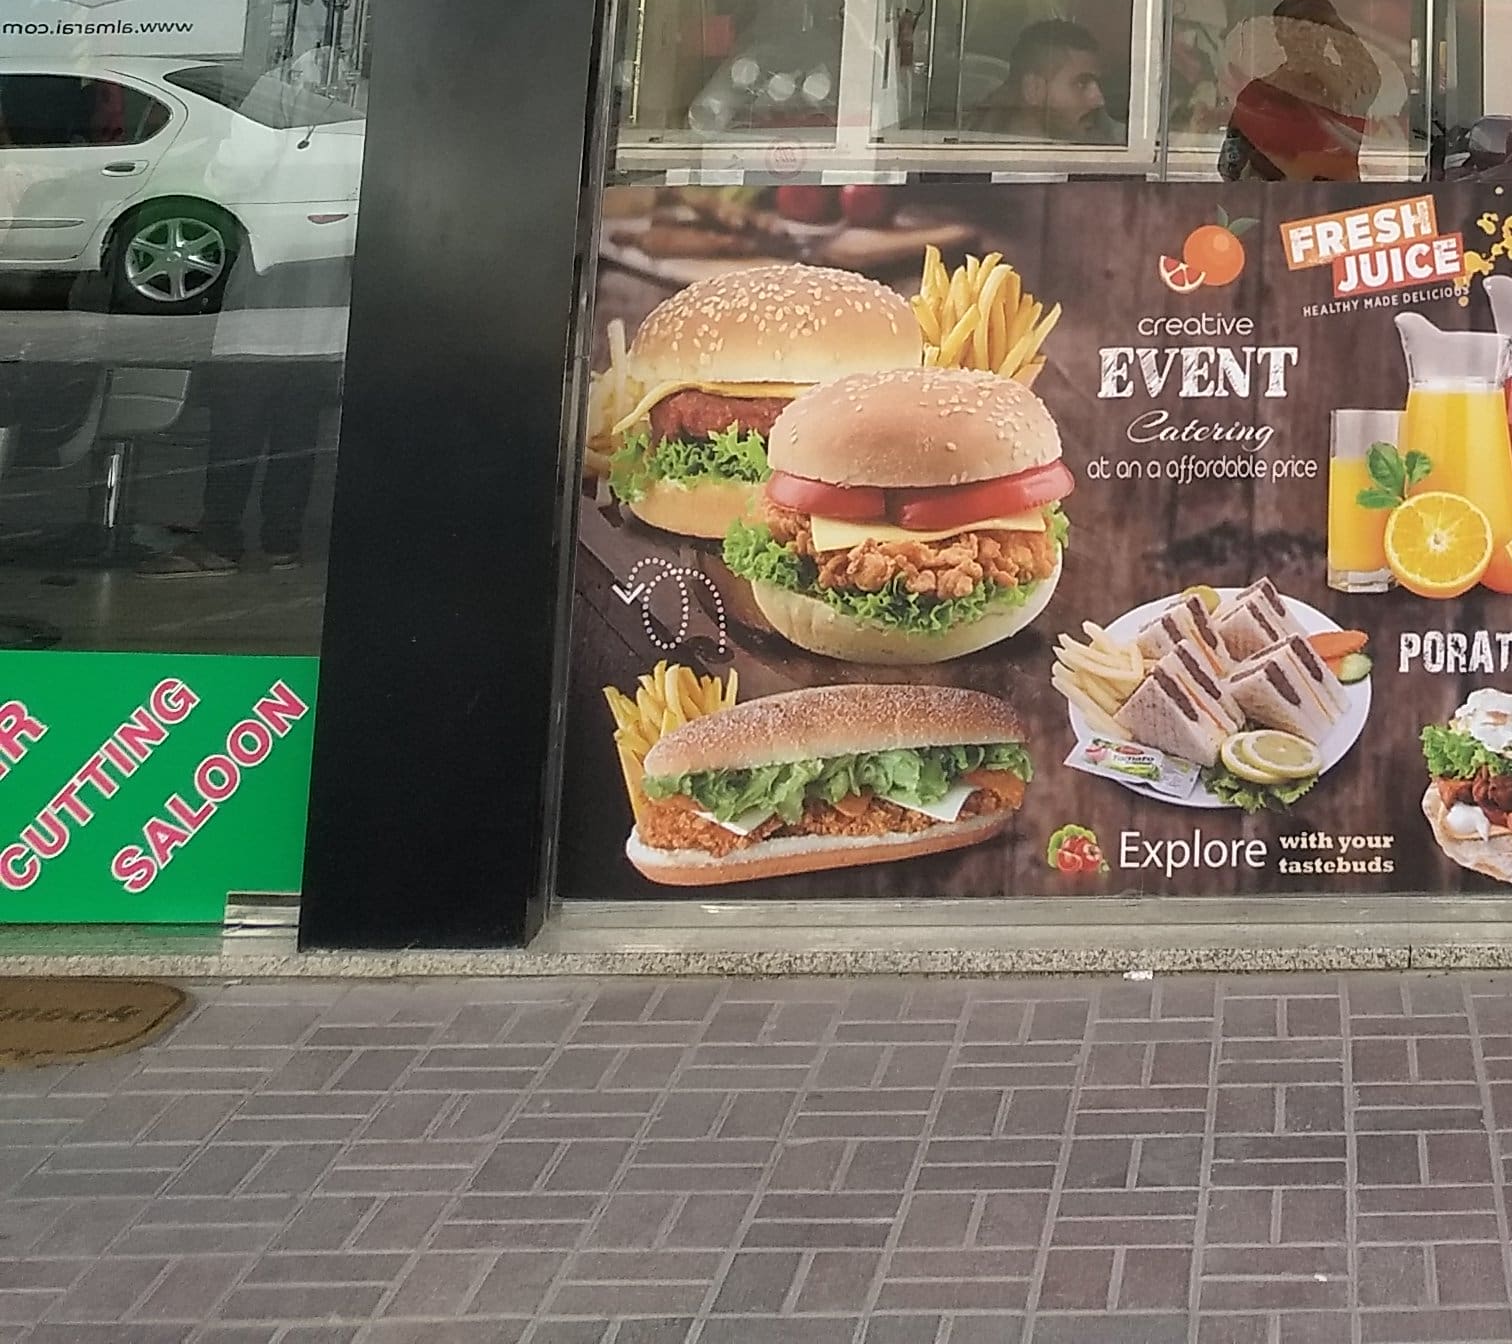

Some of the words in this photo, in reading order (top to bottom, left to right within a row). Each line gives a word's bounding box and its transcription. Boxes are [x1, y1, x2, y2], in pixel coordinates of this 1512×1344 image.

[1288, 200, 1432, 263] FRESH
[1337, 237, 1461, 293] JUICE
[1137, 312, 1255, 336] creative
[1302, 298, 1360, 318] HEALTHY
[1363, 295, 1399, 310] MADE
[1097, 346, 1299, 399] EVENT
[1126, 409, 1275, 453] Catering
[1086, 455, 1112, 479] at
[1115, 460, 1142, 479] an
[1146, 460, 1162, 479] a
[1165, 455, 1268, 485] affordable
[1272, 455, 1319, 484] price
[0, 676, 201, 892] CUTTING
[110, 679, 310, 894] SALOON
[1118, 830, 1268, 878] Explore
[1278, 829, 1333, 852] with
[1337, 832, 1395, 857] your
[1278, 855, 1395, 876] tastebuds
